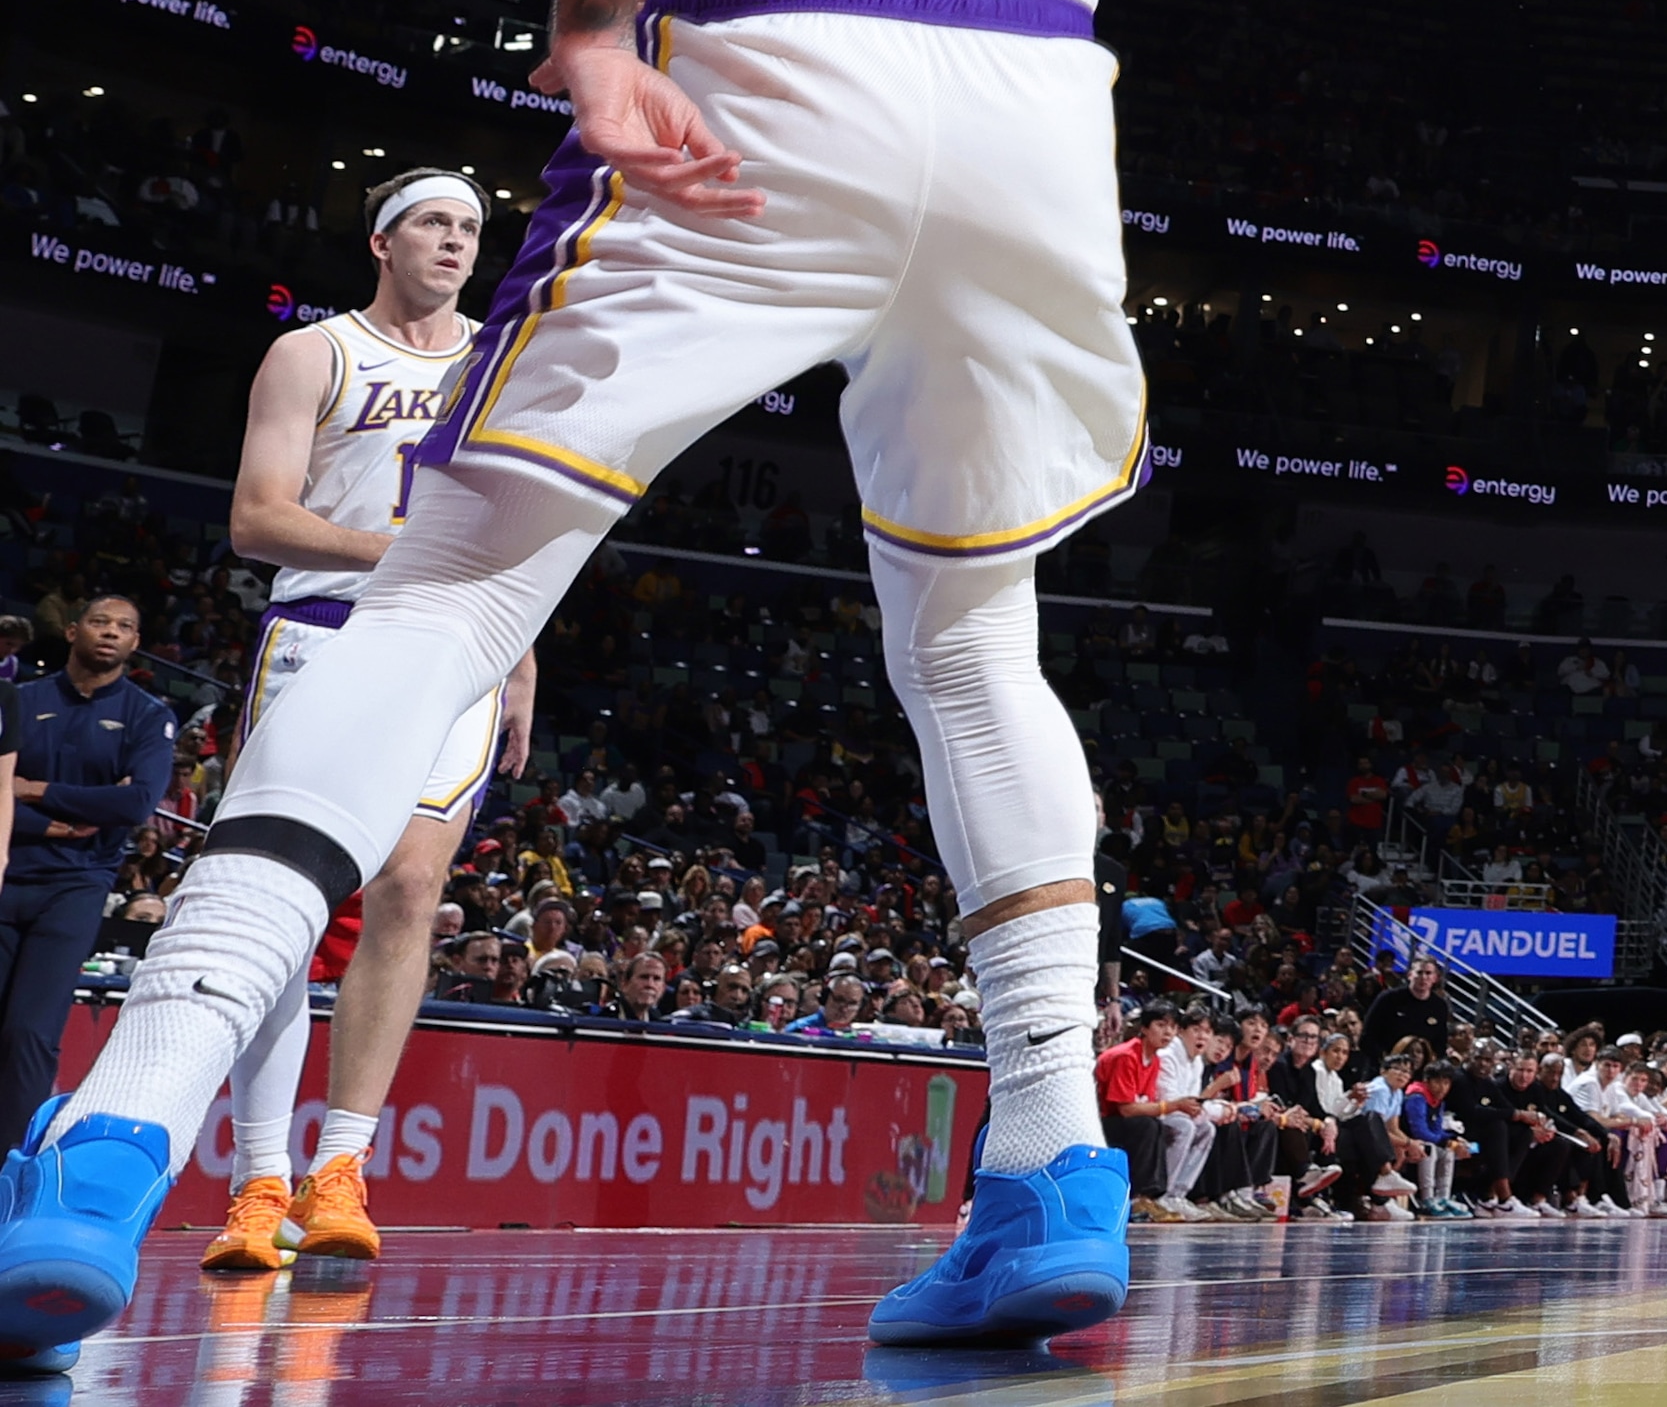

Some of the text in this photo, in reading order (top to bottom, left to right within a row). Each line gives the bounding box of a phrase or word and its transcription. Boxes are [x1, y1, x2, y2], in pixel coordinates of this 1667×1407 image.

[194, 0, 231, 29] life.
[320, 43, 407, 89] entergy
[471, 75, 577, 115] We powe
[1121, 208, 1170, 233] ergy
[1227, 218, 1361, 252] We power life.
[31, 233, 70, 264] We
[75, 249, 154, 284] power
[1444, 250, 1522, 280] entergy
[1576, 263, 1605, 282] We
[346, 381, 444, 434] LAK
[1237, 448, 1269, 469] We
[1276, 455, 1341, 478] power
[719, 456, 779, 510] 116
[1473, 478, 1555, 505] entergy
[1607, 483, 1640, 504] We
[1446, 928, 1596, 959] FANDUEL
[467, 1084, 663, 1186] Done
[682, 1092, 851, 1211] Right
